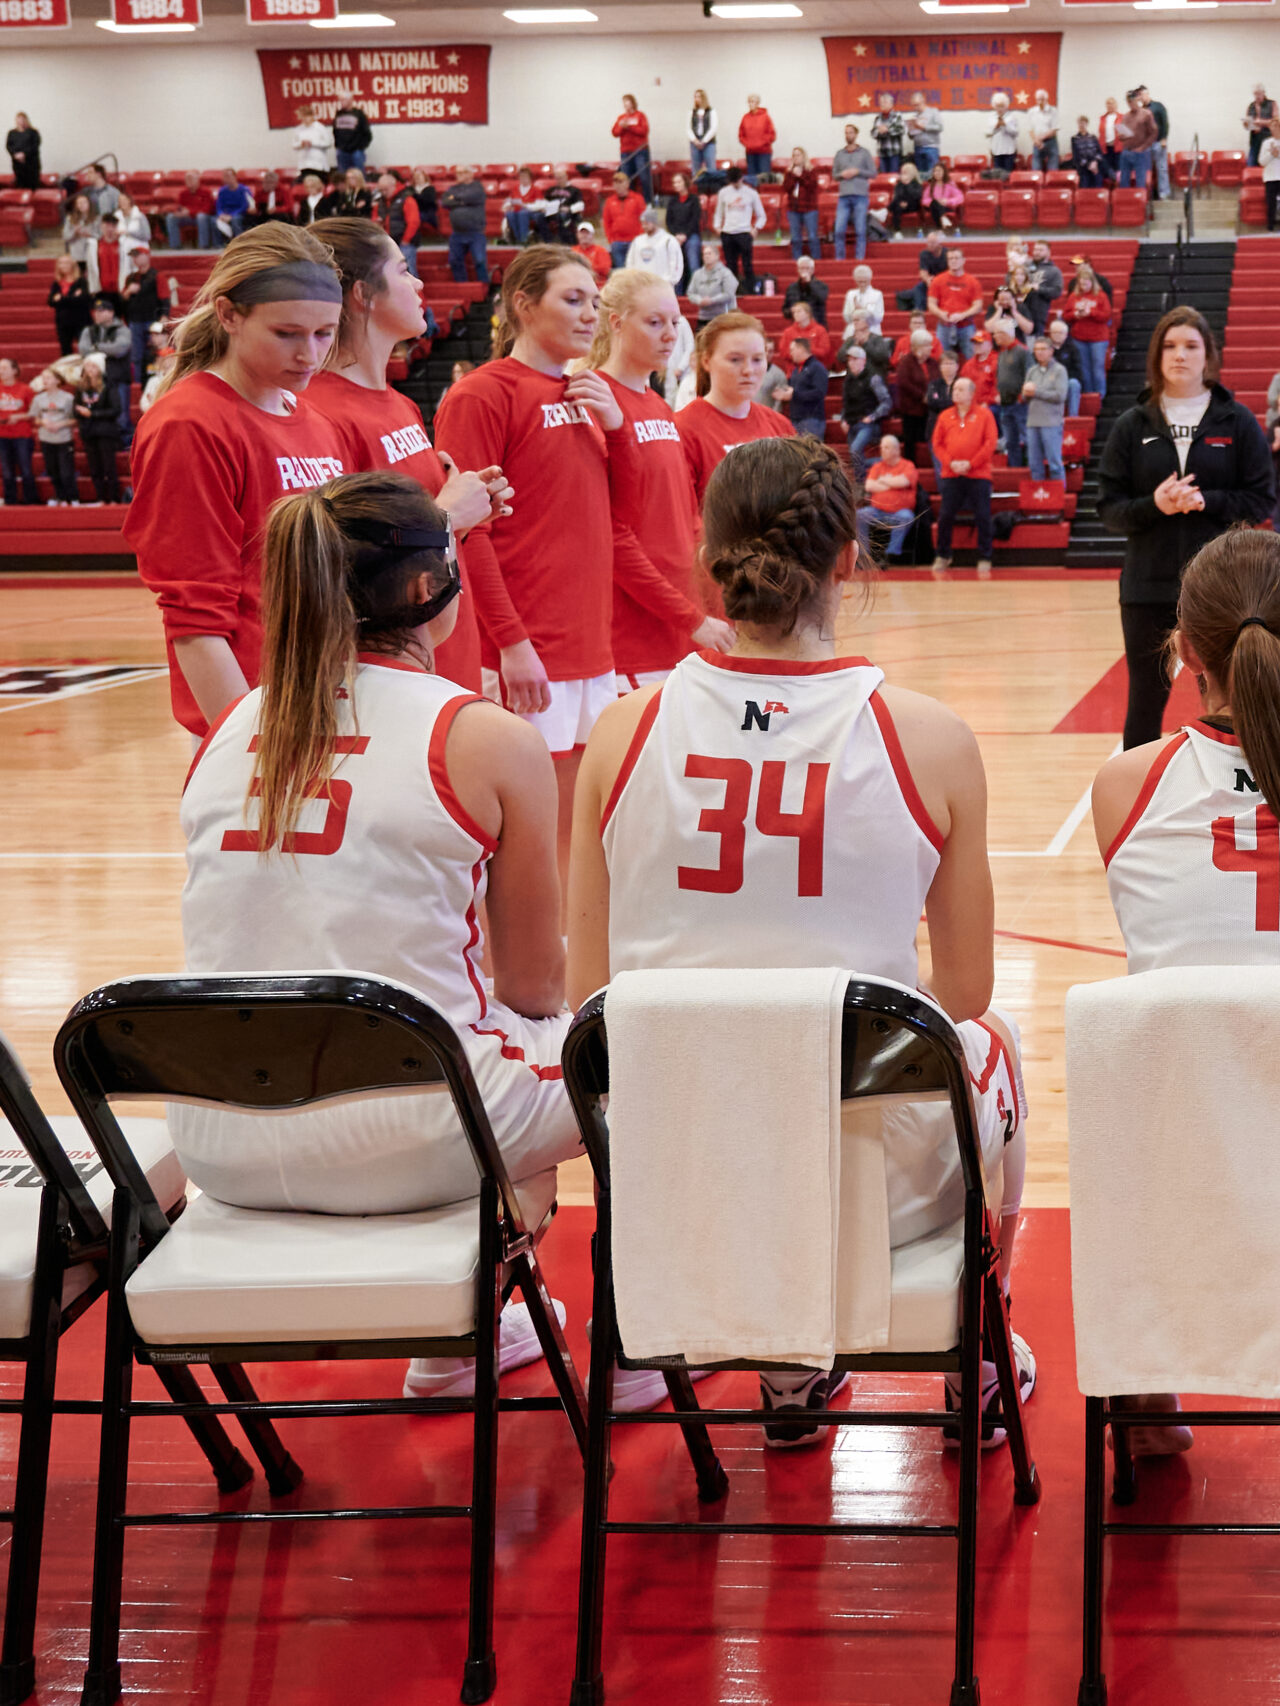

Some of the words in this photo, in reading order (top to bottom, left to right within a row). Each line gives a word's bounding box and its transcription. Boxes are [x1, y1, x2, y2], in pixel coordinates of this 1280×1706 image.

[0, 0, 54, 21] 1983
[129, 0, 184, 19] 1984
[928, 39, 1009, 57] NATIONAL
[308, 52, 352, 72] NAIA
[360, 51, 439, 71] NATIONAL
[847, 65, 930, 83] FOOTBALL
[938, 63, 1039, 81] CHAMPIONS
[282, 76, 364, 98] FOOTBALL
[372, 75, 469, 95] CHAMPIONS
[678, 754, 831, 897] 34
[1211, 804, 1280, 932] 4
